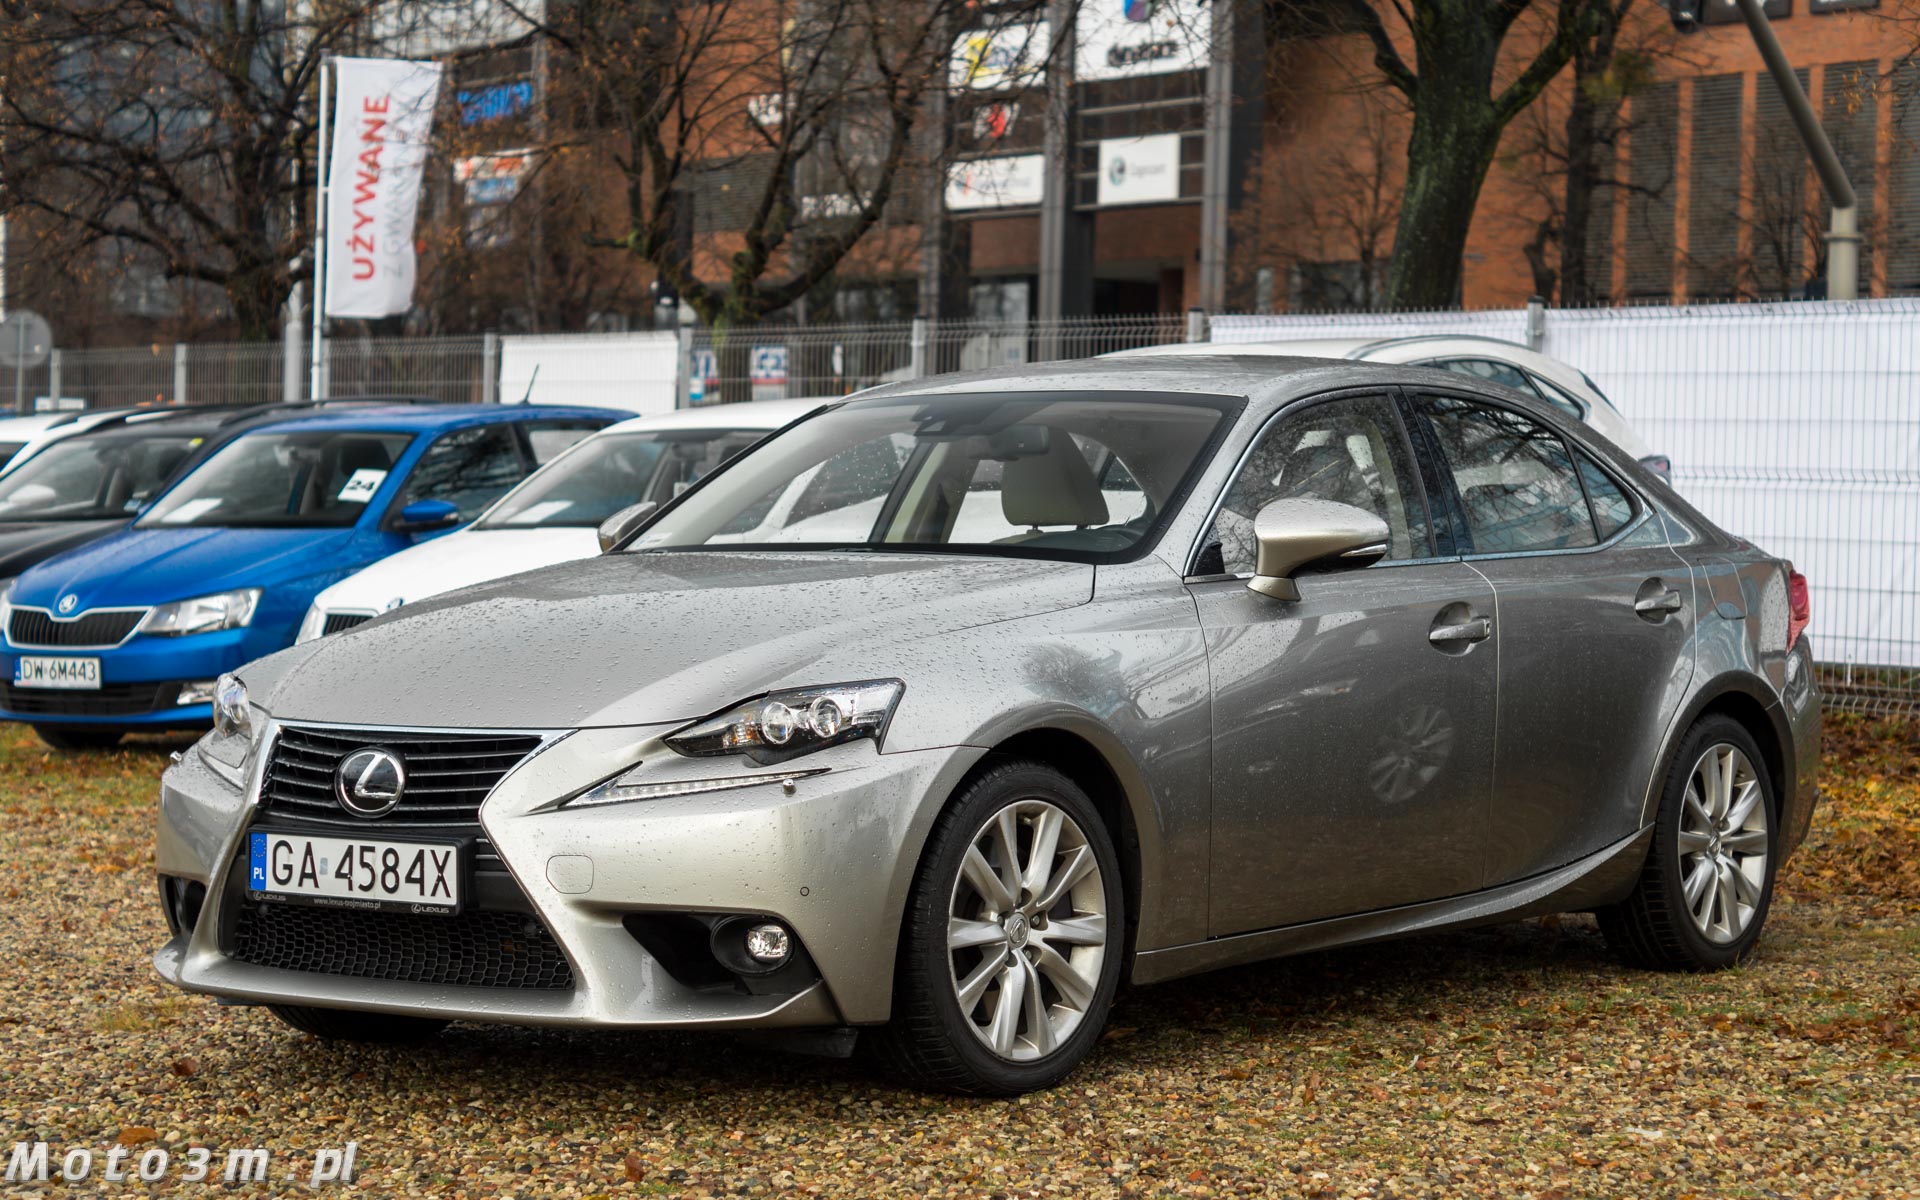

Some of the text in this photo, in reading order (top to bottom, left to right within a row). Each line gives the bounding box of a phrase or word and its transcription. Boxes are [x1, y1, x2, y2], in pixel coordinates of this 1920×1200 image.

[346, 95, 391, 281] UŻYWANE
[347, 480, 376, 492] 24
[23, 659, 97, 681] DW 6M443
[253, 866, 265, 881] PL
[271, 839, 452, 899] GA 4584X
[421, 905, 450, 914] LEXUS
